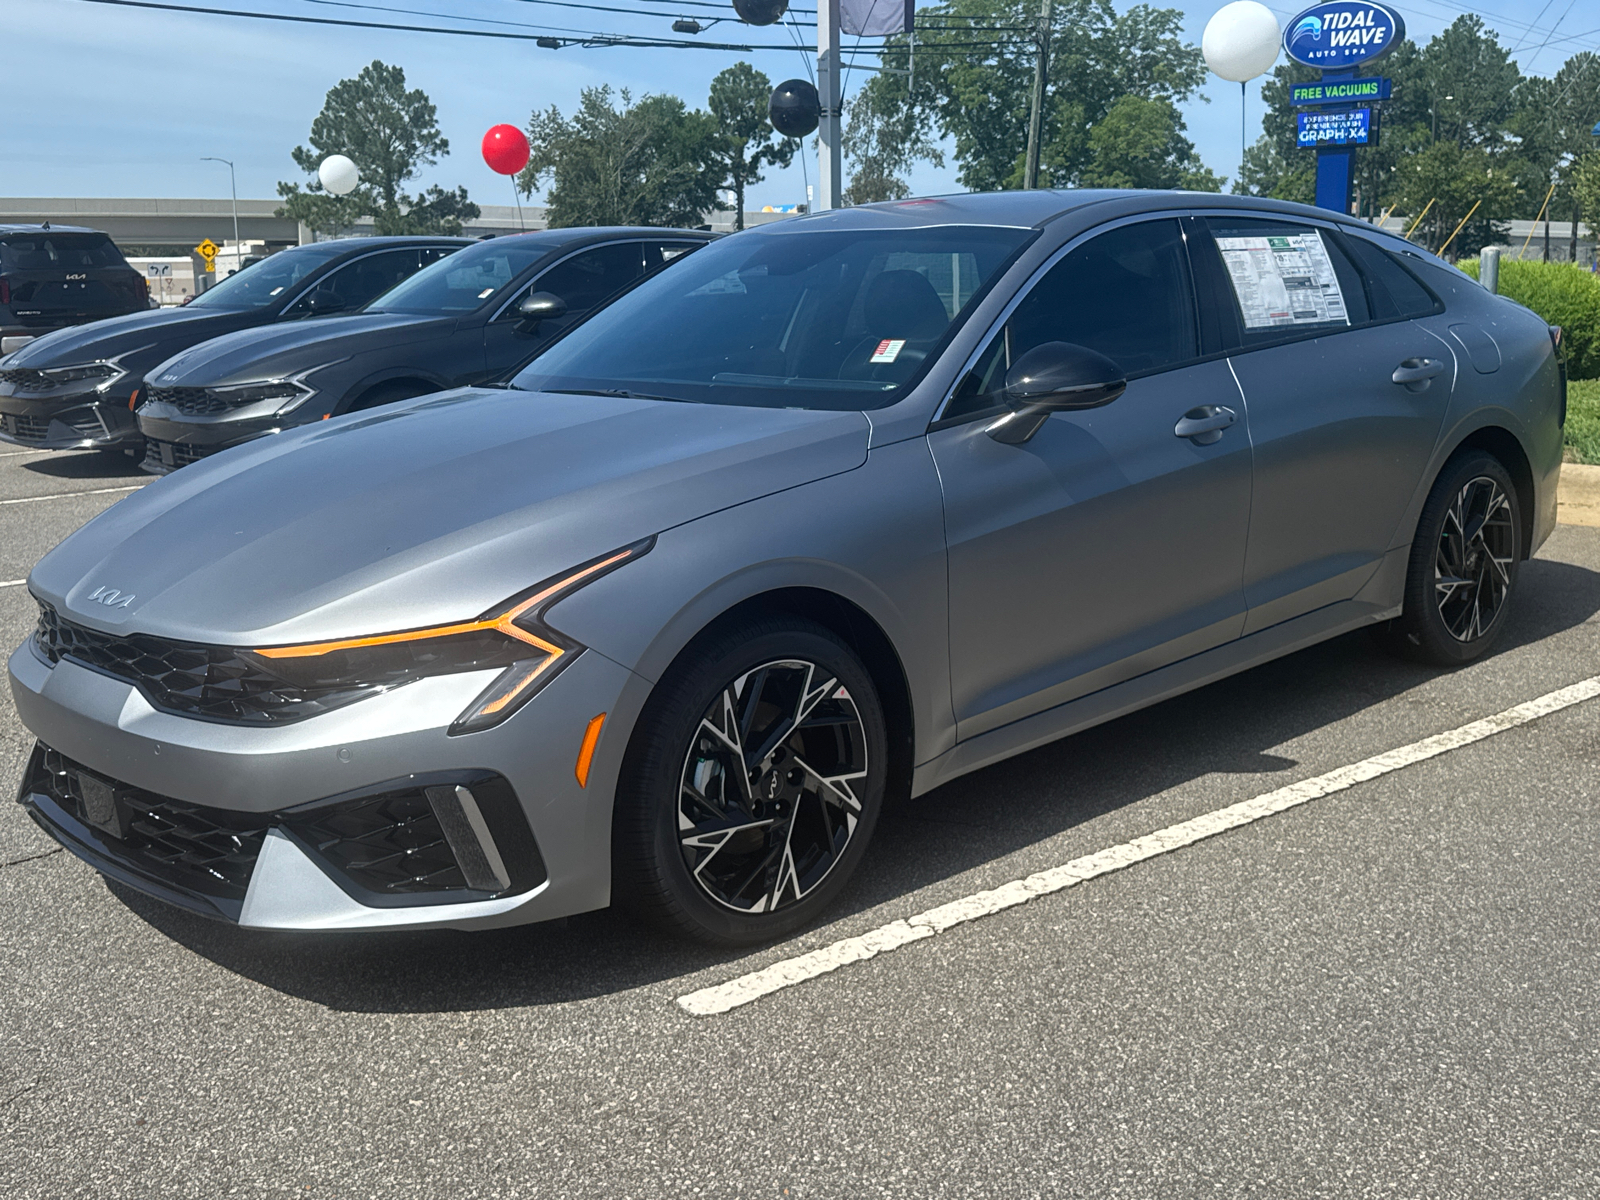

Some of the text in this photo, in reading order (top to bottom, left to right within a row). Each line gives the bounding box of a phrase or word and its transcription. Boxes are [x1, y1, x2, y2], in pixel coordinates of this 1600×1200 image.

[1323, 10, 1375, 30] TIDAL
[1330, 27, 1386, 47] WAVE
[1308, 50, 1337, 58] AUTO
[1294, 82, 1378, 100] FREE VACUUMS
[87, 585, 136, 609] KIA
